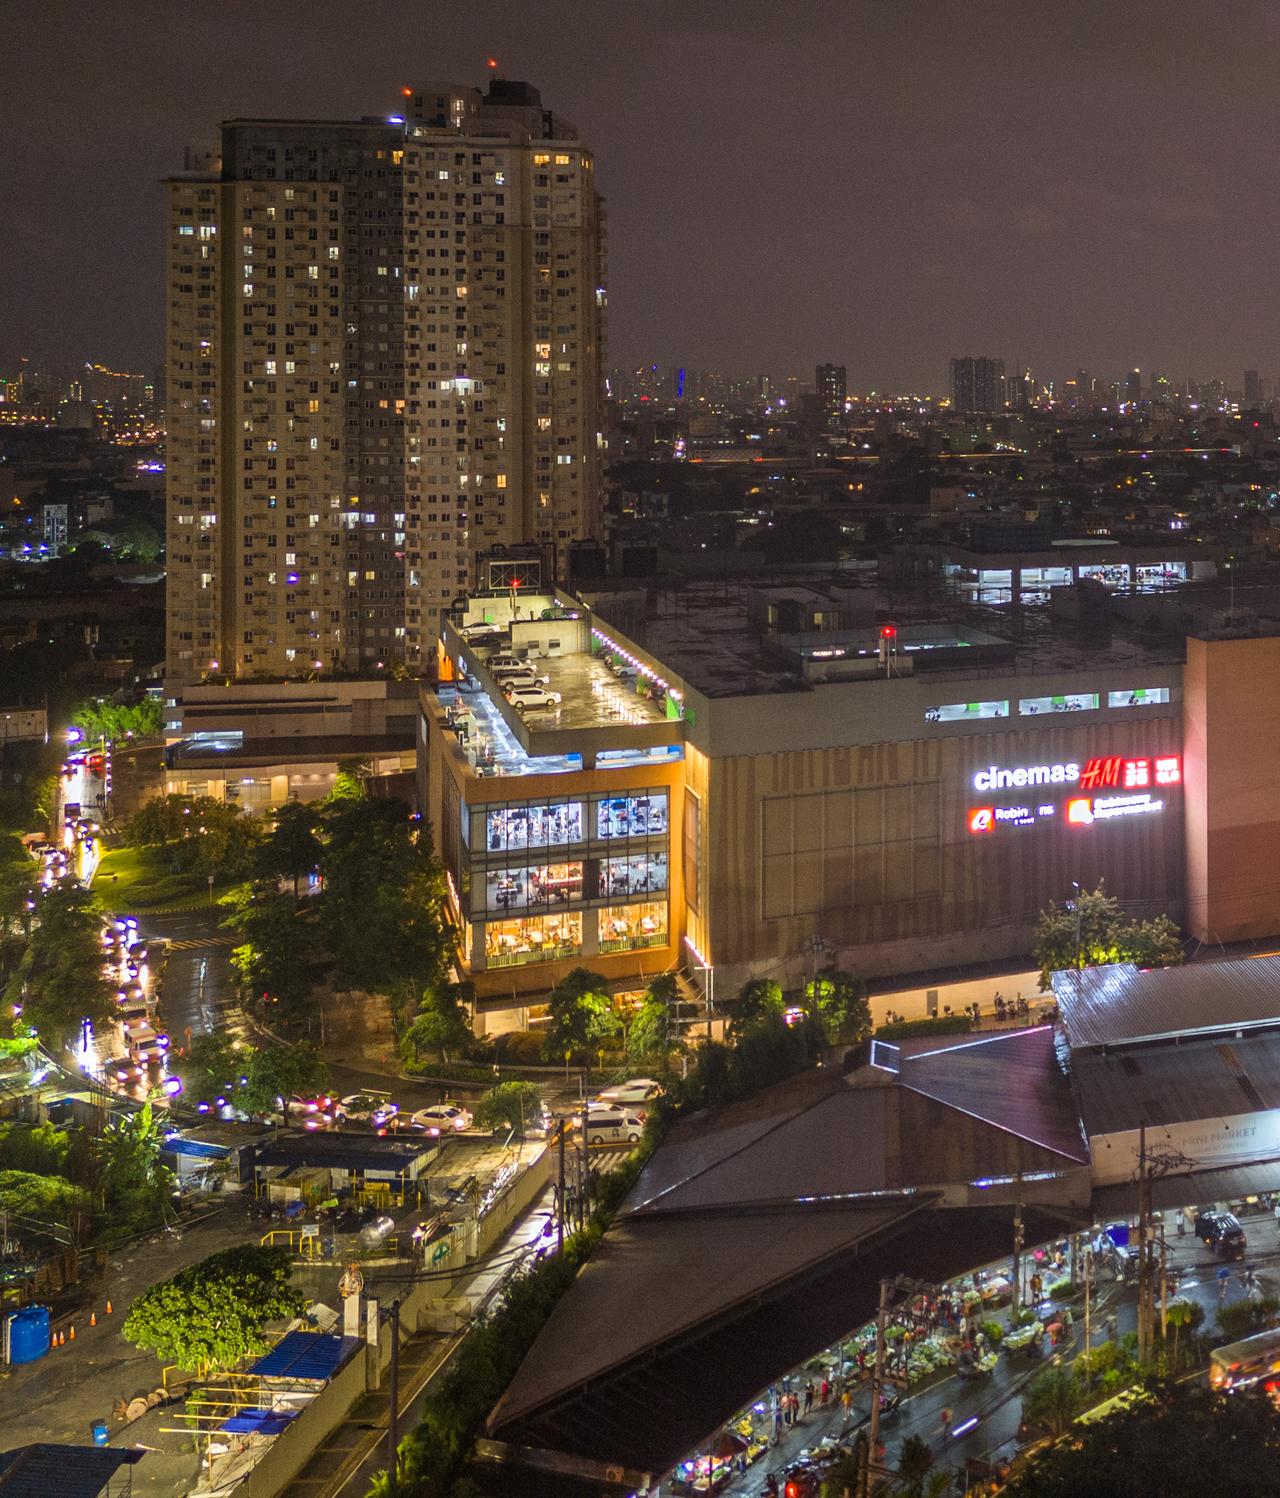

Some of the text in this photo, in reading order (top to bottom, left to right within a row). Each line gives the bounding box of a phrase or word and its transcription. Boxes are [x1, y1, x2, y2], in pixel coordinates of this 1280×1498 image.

[974, 763, 1080, 790] cinemas
[1080, 756, 1122, 789] H&M
[995, 805, 1055, 820] Robinns
[1211, 1126, 1257, 1143] MARKET
